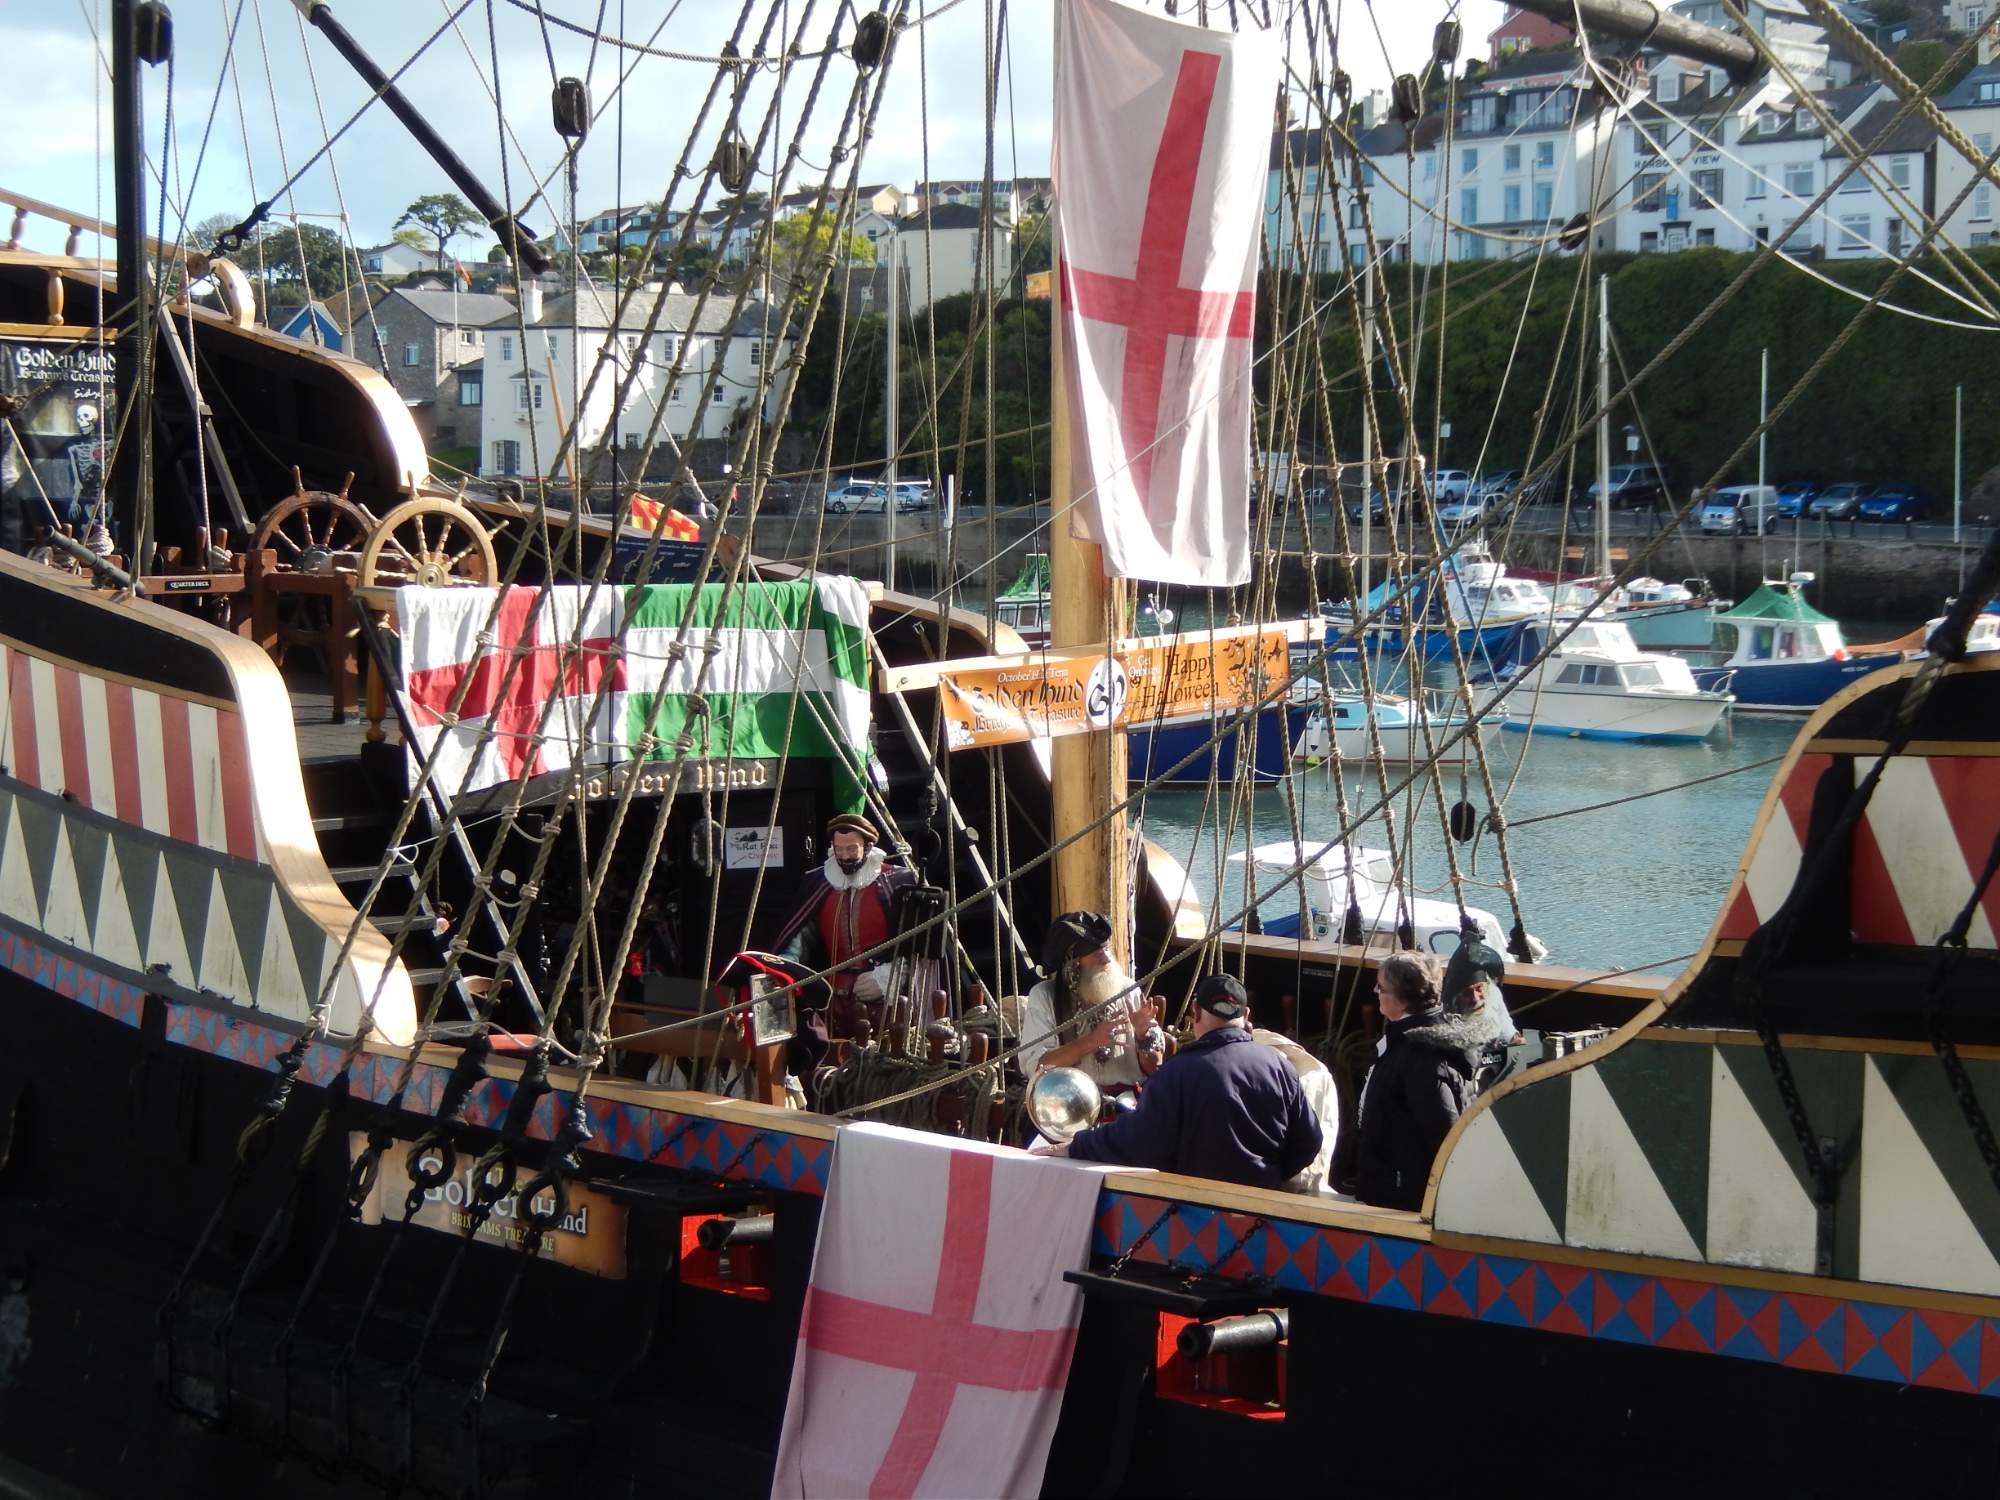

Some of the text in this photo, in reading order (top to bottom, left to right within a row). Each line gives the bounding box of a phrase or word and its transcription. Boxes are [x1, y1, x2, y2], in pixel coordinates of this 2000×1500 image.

[1634, 155, 1721, 169] HARBOR VIEW
[16, 346, 116, 371] Golden Hind
[998, 671, 1030, 683] October
[1166, 652, 1216, 681] Happy
[1141, 681, 1219, 708] Haloween
[696, 761, 767, 788] Hind
[534, 1196, 588, 1235] Hnd
[451, 1212, 554, 1252] BRIXAMS TRERE
